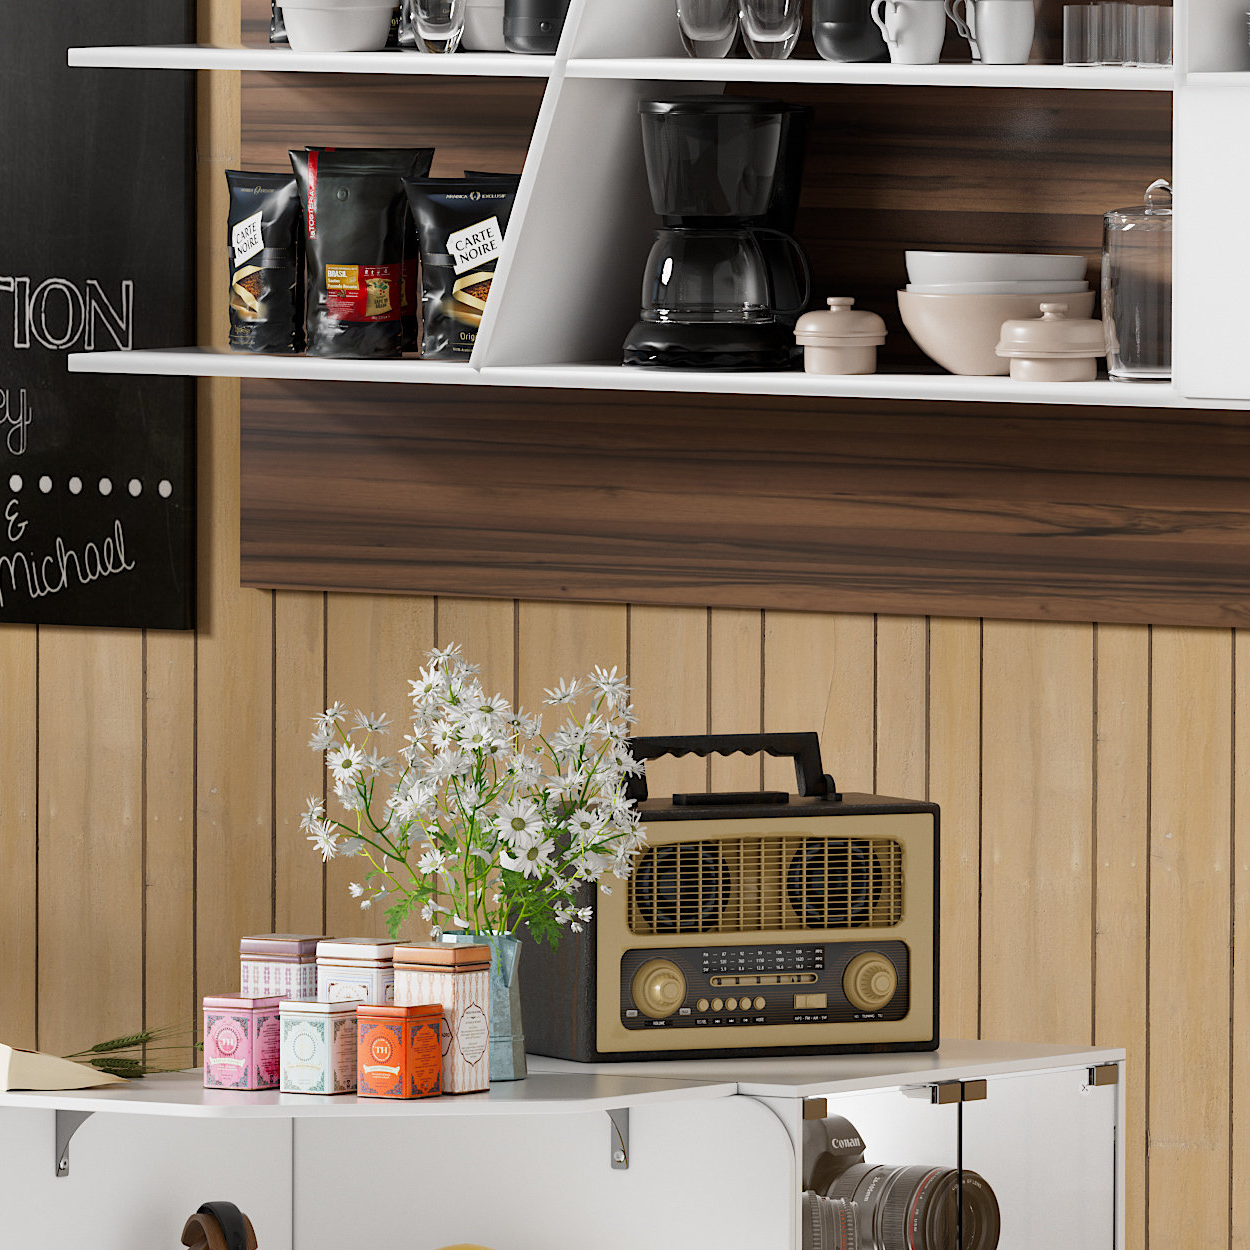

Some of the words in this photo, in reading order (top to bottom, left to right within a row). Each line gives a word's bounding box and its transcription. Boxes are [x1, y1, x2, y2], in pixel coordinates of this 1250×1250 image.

[236, 221, 257, 244] CARTE
[237, 234, 259, 255] NOIRE
[455, 227, 495, 252] CARTE
[459, 240, 498, 264] NOIRE
[5, 499, 29, 541] &
